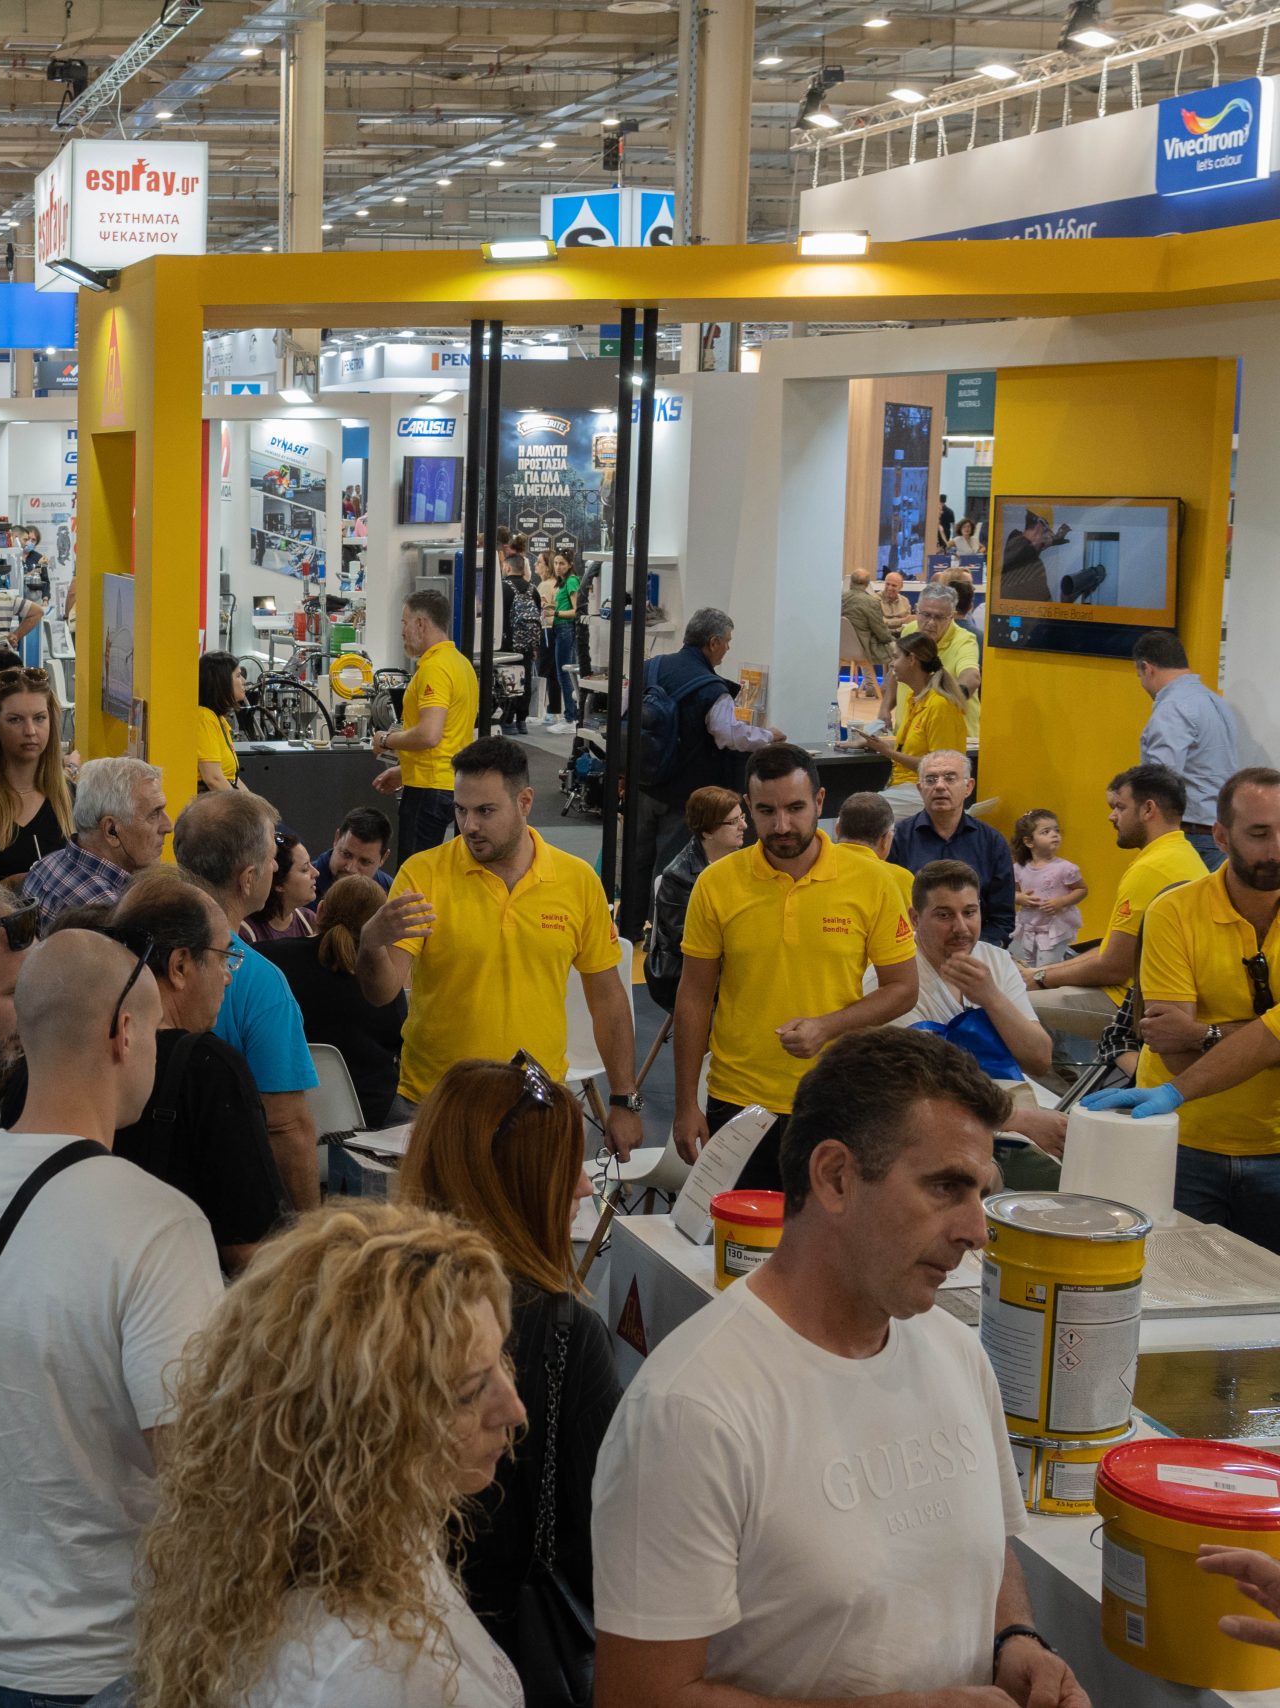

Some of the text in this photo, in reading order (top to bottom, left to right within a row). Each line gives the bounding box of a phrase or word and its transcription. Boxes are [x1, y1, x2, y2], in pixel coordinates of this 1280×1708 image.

[1163, 129, 1244, 160] Vivechrom
[1215, 153, 1243, 169] colour
[85, 158, 199, 196] espray.gr
[99, 212, 180, 225] ΣΥΣΤΗΜΑΤΑ
[99, 231, 179, 243] ΨΕΚΑΣΜΟΥ
[399, 420, 454, 435] CARLISLE
[270, 437, 310, 456] DYNASET
[518, 445, 568, 457] Η ΑΠΟΛΥΤΗ
[518, 459, 568, 470] ΠΡΟΣΤΑΣΙΑ
[524, 471, 560, 483] ΓΙΑ ΟΛΑ
[513, 484, 571, 496] ΤΑ ΜΕΤΑΛΛΑ
[541, 913, 564, 923] Sealing
[822, 917, 846, 926] Sealing
[541, 922, 566, 932] Bonding
[822, 926, 849, 935] Bonding
[727, 1248, 743, 1260] 130
[821, 1424, 977, 1512] GUESS
